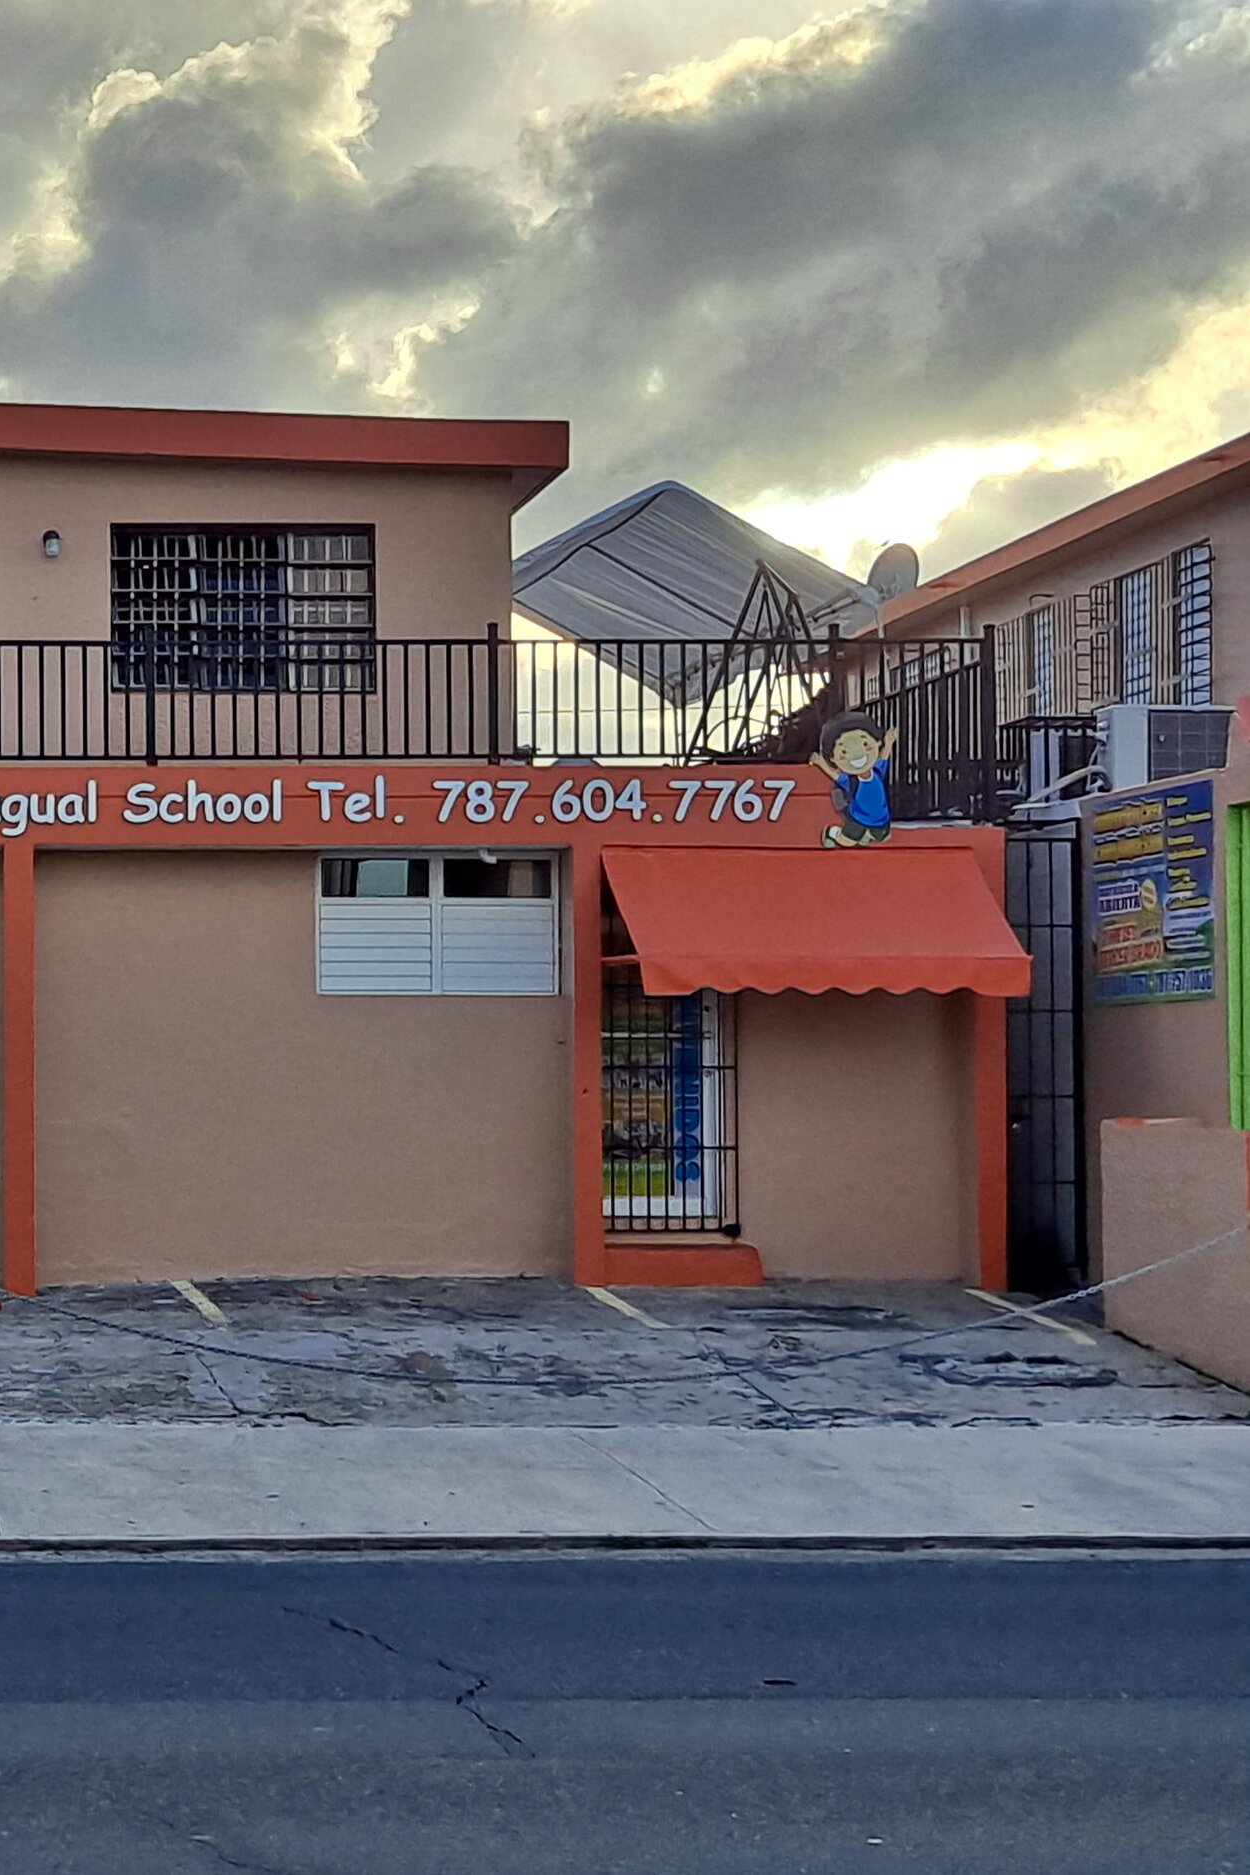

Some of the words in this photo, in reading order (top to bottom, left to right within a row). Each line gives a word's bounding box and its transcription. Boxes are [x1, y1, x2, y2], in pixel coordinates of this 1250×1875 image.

[122, 777, 283, 824] School
[306, 773, 405, 824] Tel.
[431, 778, 797, 825] 787.604.7767
